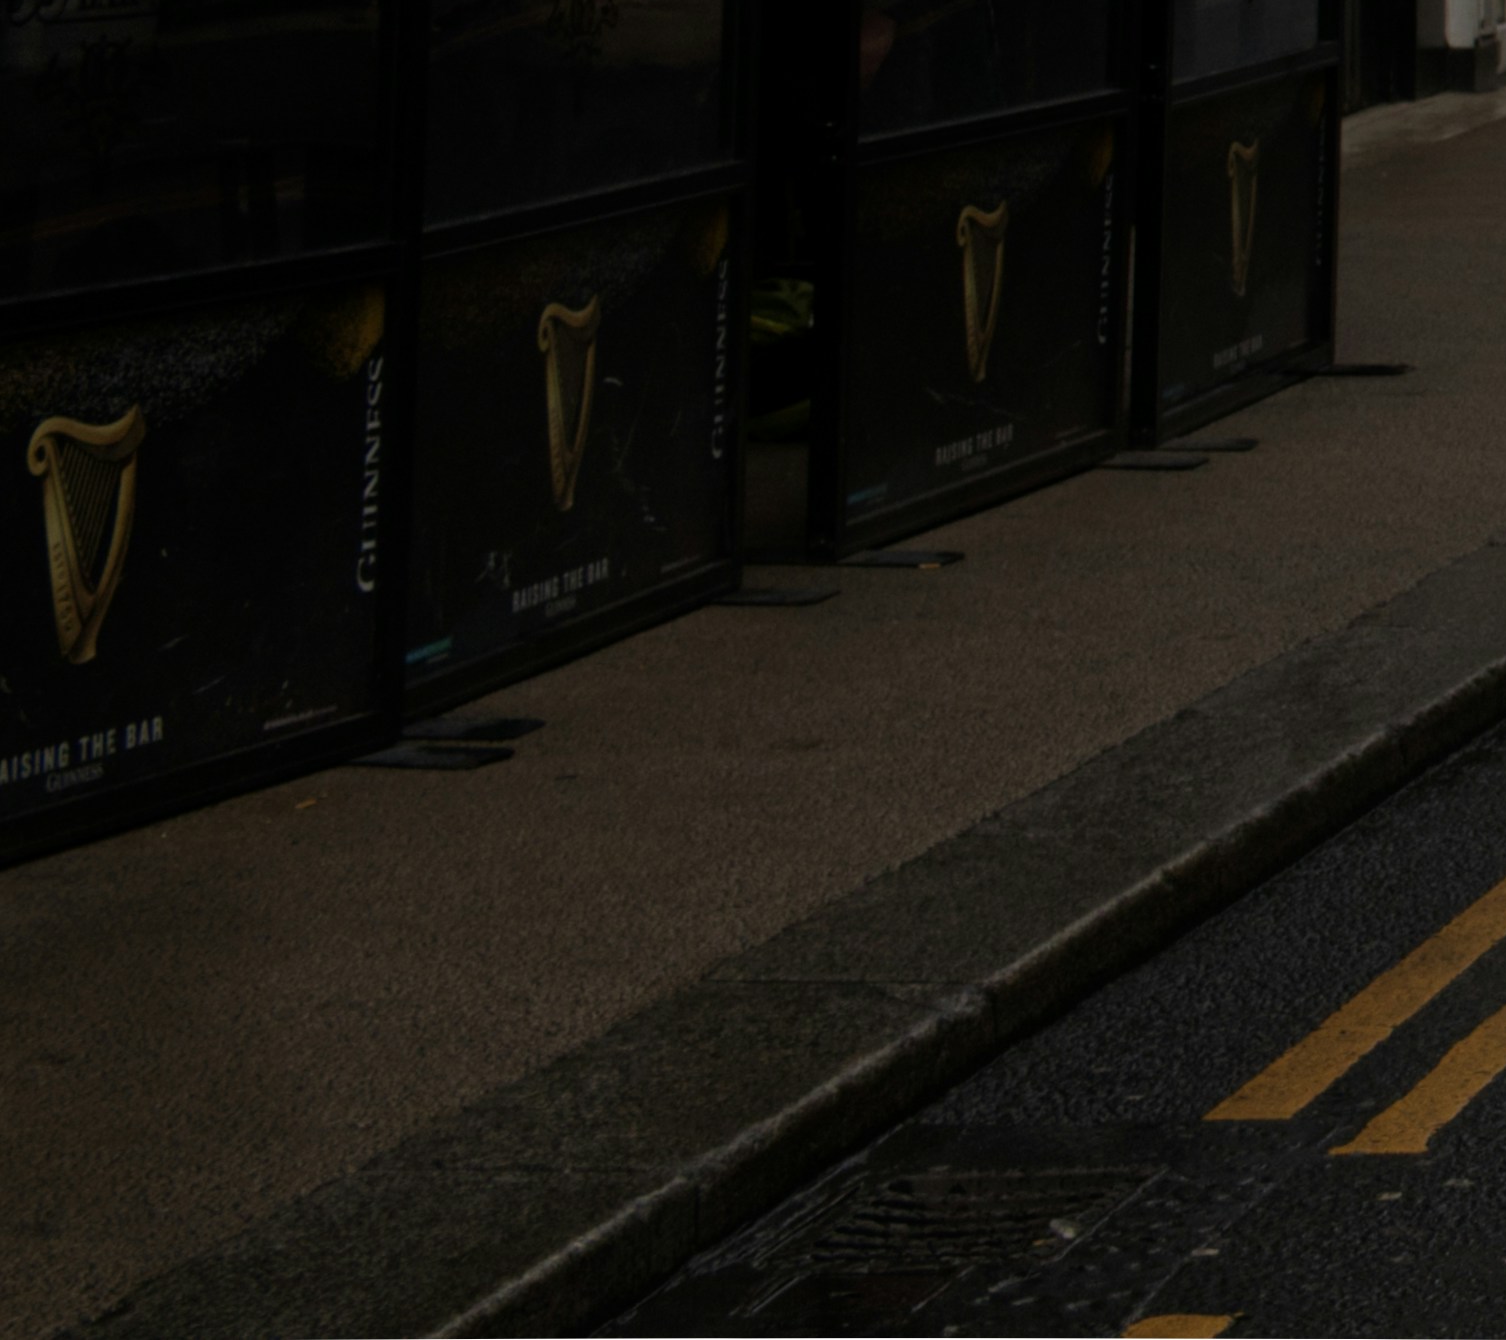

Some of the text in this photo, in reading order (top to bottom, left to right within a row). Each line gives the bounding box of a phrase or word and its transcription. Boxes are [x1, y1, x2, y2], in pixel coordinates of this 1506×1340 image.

[711, 258, 729, 460] GUINNESS
[355, 354, 385, 594] GUINNESS
[512, 575, 560, 614] RAISING
[562, 566, 584, 594] THE
[586, 556, 609, 584] BAR
[78, 726, 118, 762] THE
[124, 714, 164, 752] BAR
